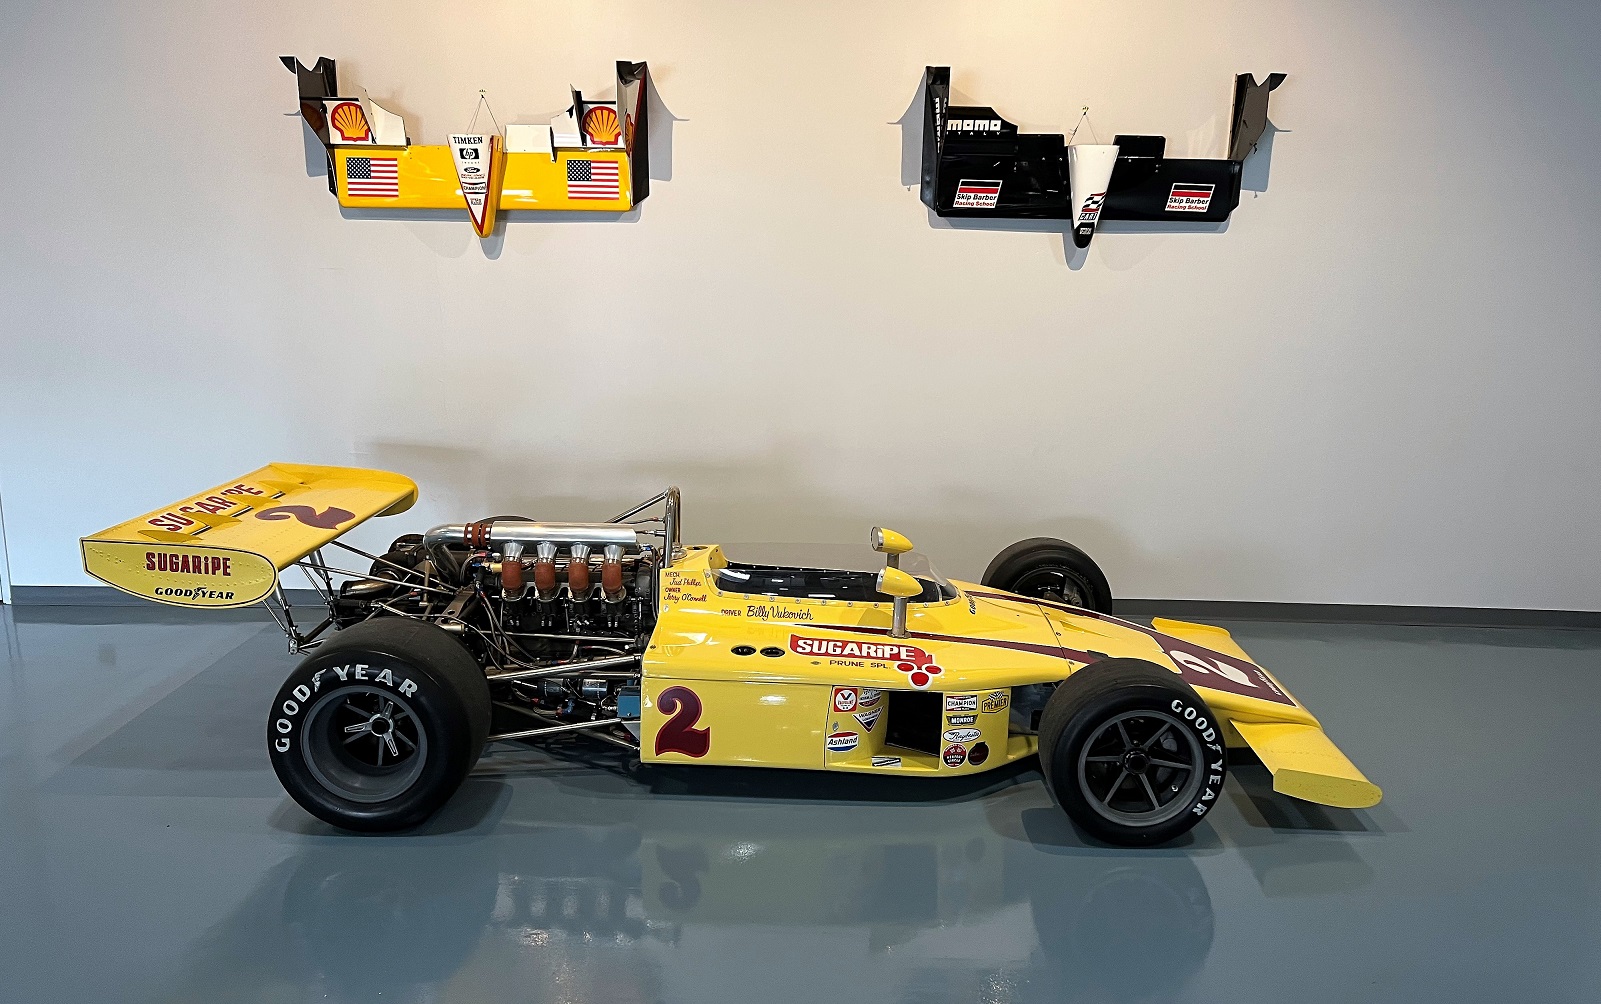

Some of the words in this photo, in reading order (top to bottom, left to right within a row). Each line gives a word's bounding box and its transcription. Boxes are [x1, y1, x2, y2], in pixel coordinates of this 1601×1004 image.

[947, 120, 1001, 131] momo
[453, 136, 483, 144] TIMKEN
[255, 505, 356, 530] 2
[146, 551, 231, 577] SUGARiPE
[746, 605, 770, 621] Billy
[770, 606, 813, 620] Vukovich
[796, 639, 916, 660] SUGARiPE
[829, 660, 865, 668] PRUNE
[1169, 650, 1260, 688] 2
[983, 698, 1007, 711] PREMIER
[655, 685, 711, 758] 2
[951, 716, 974, 724] MONROE
[828, 737, 858, 745] Ashland
